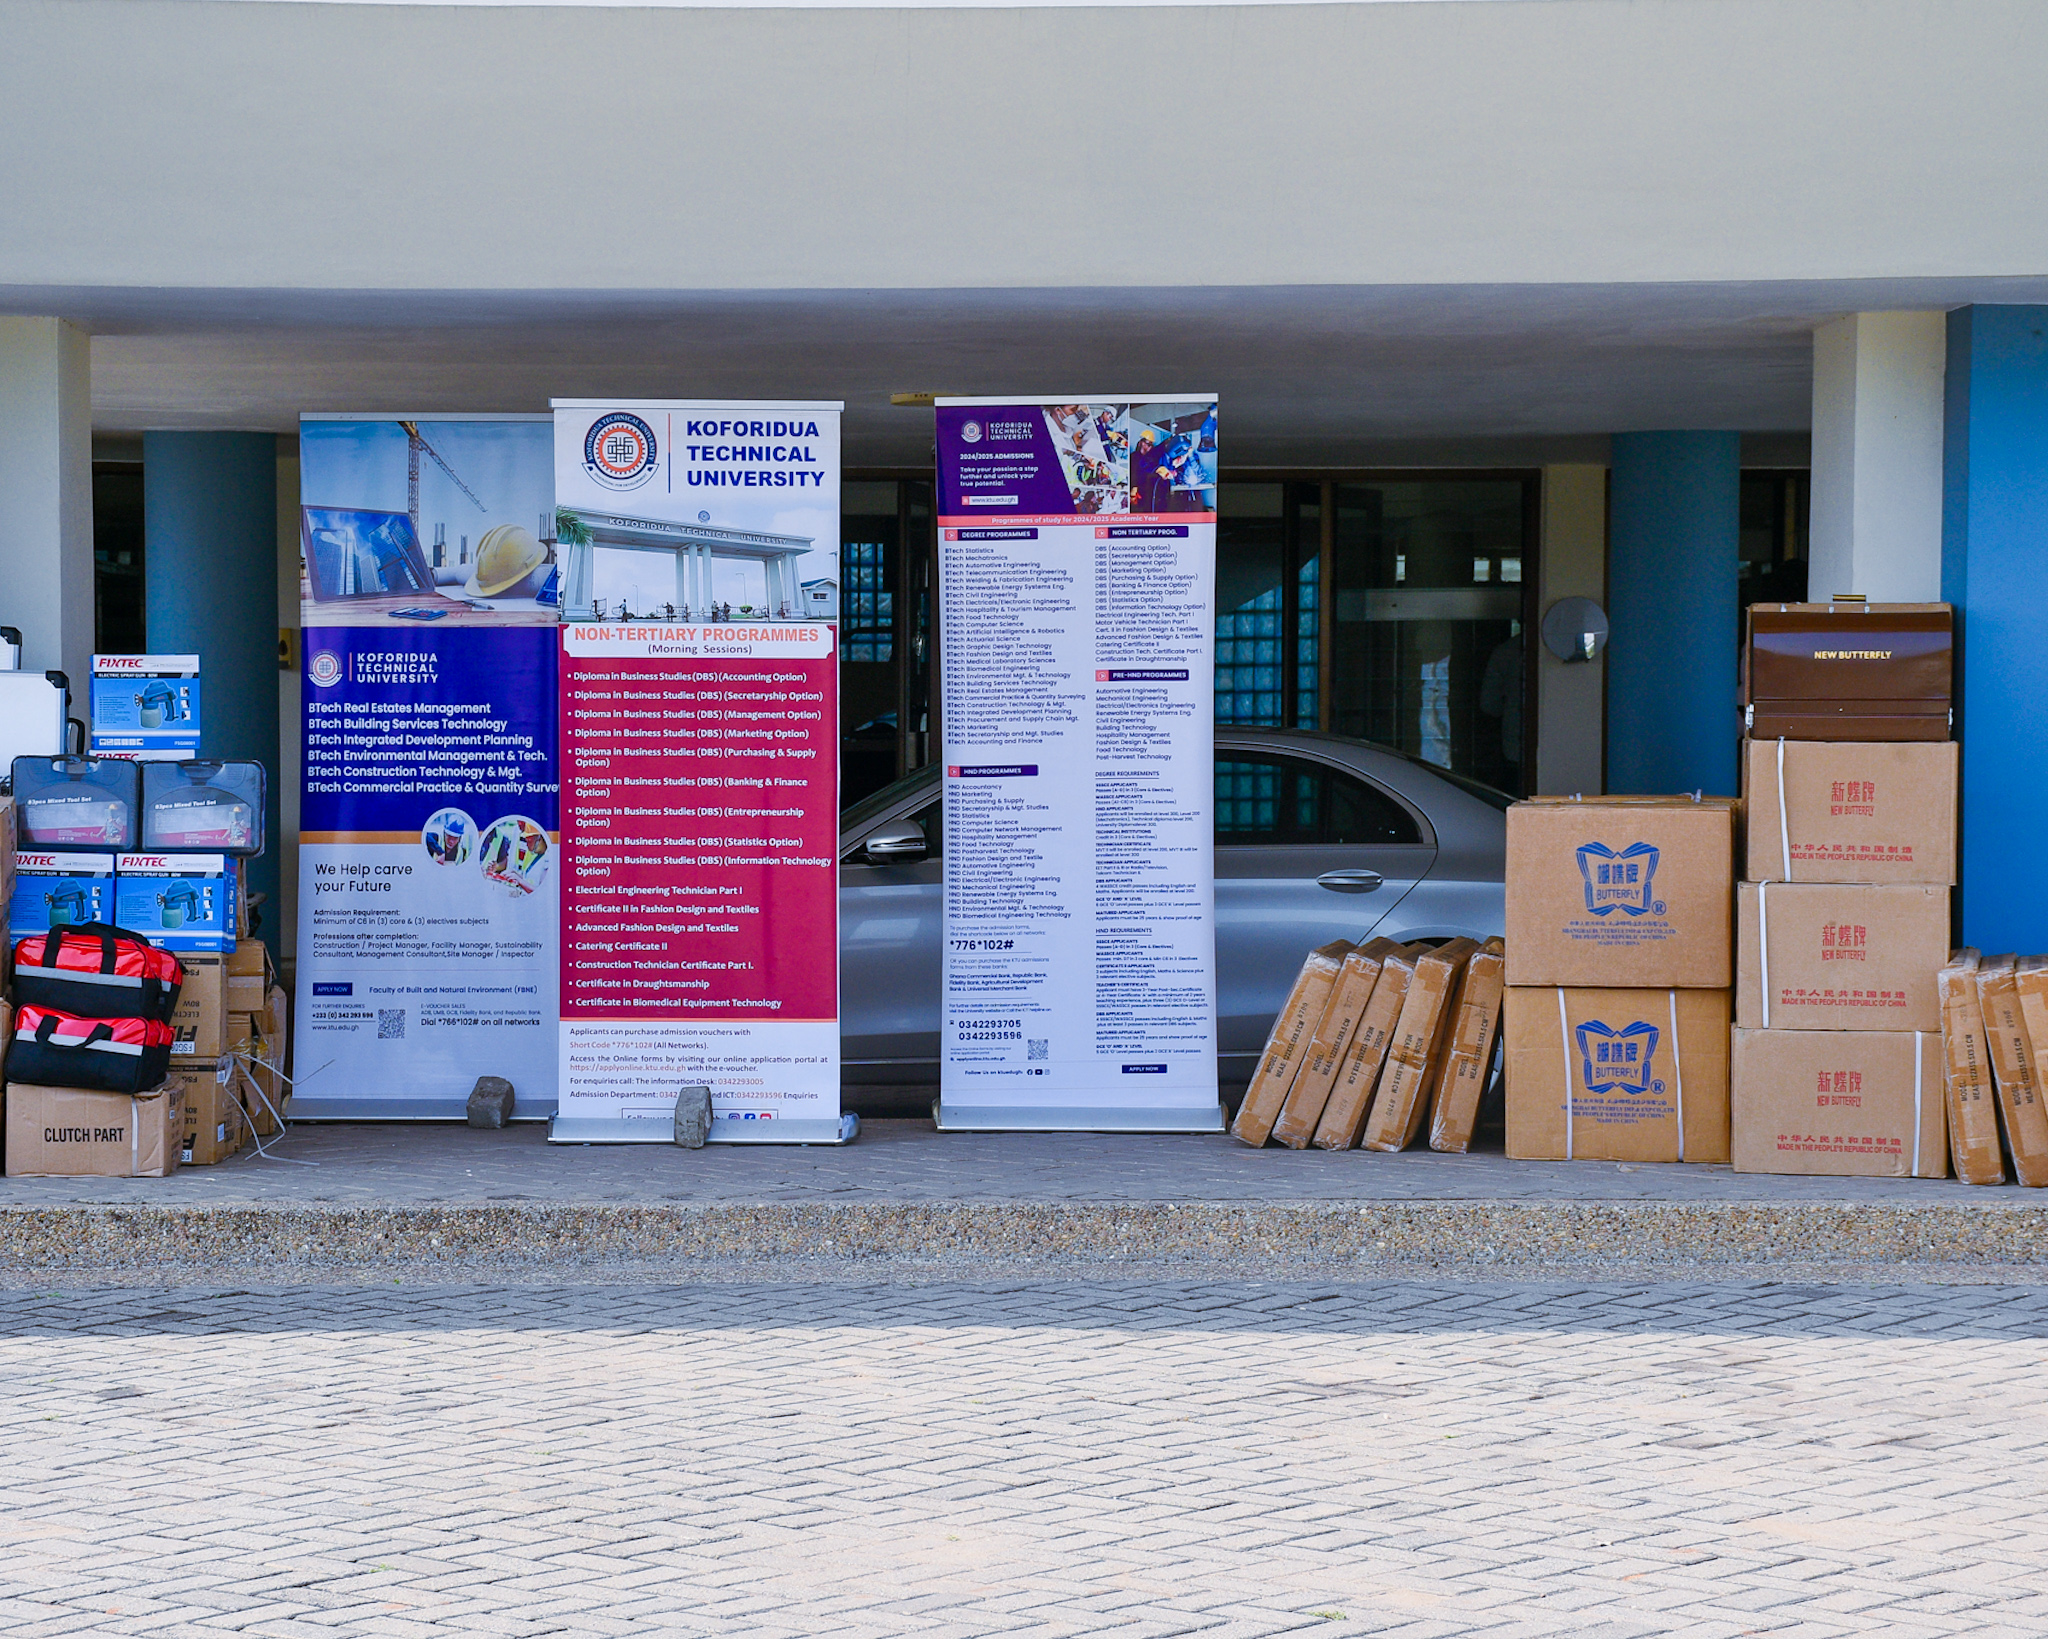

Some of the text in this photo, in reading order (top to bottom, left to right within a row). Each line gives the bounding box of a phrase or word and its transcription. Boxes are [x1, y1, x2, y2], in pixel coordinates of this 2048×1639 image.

[686, 420, 819, 436] KOFORIDUA
[686, 445, 817, 461] TECHNICAL
[686, 470, 825, 486] UNIVERSITY
[574, 627, 819, 641] NON-TERTIARY PROGRAMMES
[647, 644, 753, 654] (Morning Sessions)
[1814, 650, 1892, 660] NEW BUTTERFLY
[98, 658, 144, 667] FIXTEC
[357, 652, 438, 662] KOFORIDUA
[357, 663, 435, 672] TECHNICAL
[357, 673, 439, 683] UNIVERSITY
[573, 671, 807, 683] Diploma in Business Studies (DBS) (Accounting Option)
[308, 701, 491, 716] BTech Real Estates Management
[308, 717, 508, 732] BTech Building Services Technology
[307, 749, 548, 764] BTech Environmental Management & Tech.
[307, 781, 341, 792] BTech
[343, 781, 414, 792] Commercial
[416, 781, 462, 792] Practice
[464, 781, 473, 792] &
[475, 781, 524, 795] Quantity
[1830, 805, 1875, 817] NEW BUTTERFLY
[122, 856, 168, 866] FIXTEC
[1827, 853, 1856, 861] PEOPLE'S
[1856, 854, 1886, 862] REPUBLIC
[1894, 854, 1914, 862] CHINA
[314, 863, 413, 878] We Help carve
[314, 880, 392, 895] your Future
[575, 885, 743, 896] Electrical Engineering Technician Part I
[1596, 888, 1640, 900] BUTTERFLY
[352, 909, 401, 918] Requirement:
[356, 933, 373, 942] after
[1821, 949, 1866, 961] NEW BUTTERFLY
[575, 978, 710, 990] Certificate in Draughtsmanship
[1595, 1066, 1639, 1078] BUTTERFLY
[1817, 1095, 1862, 1108] NEW BUTTERFLY
[44, 1127, 125, 1142] CLUTCH PART
